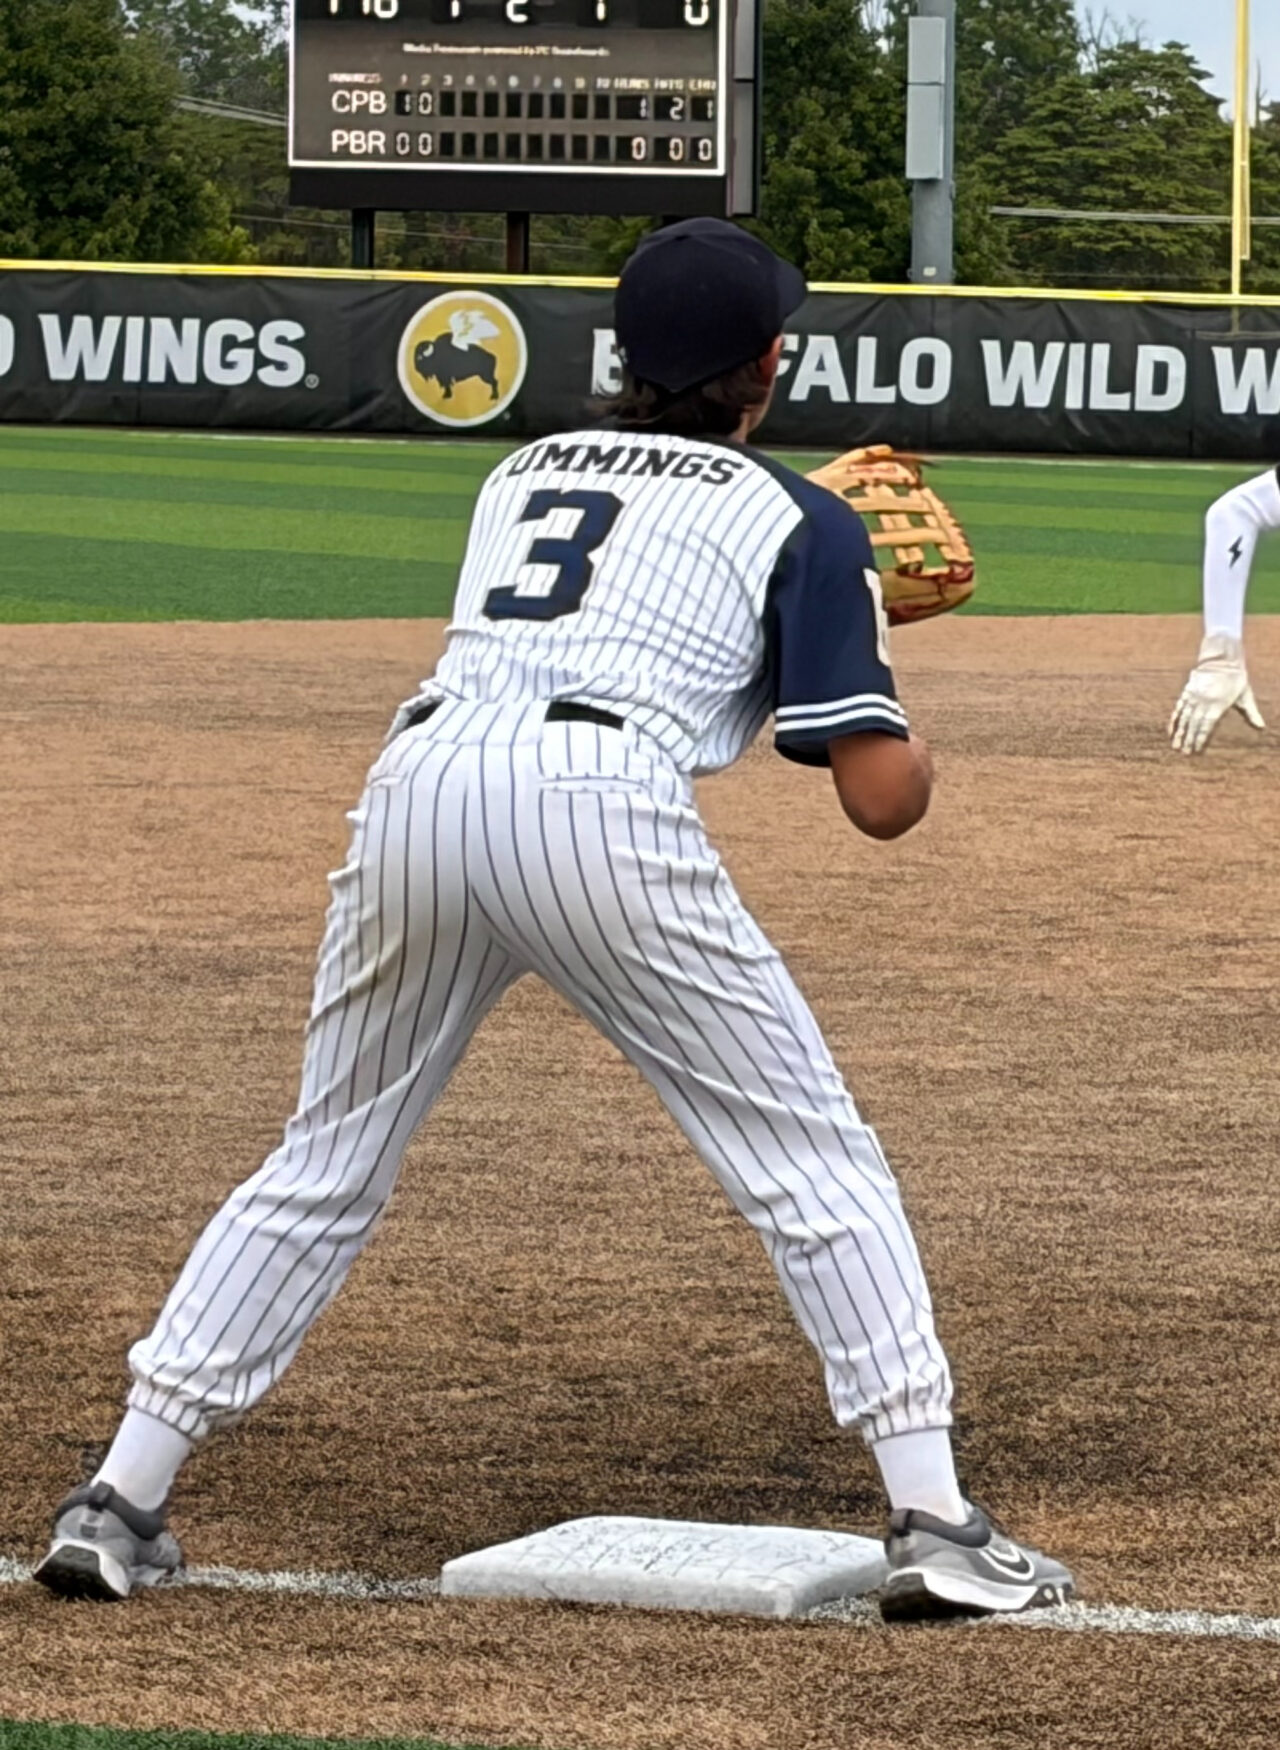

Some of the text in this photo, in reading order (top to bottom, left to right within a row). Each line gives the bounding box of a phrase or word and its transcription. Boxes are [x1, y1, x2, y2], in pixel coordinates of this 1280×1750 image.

[331, 89, 387, 114] CPB
[418, 92, 433, 115] 0
[669, 97, 684, 120] 2
[331, 129, 712, 161] PBR 0 0 0 0 0
[982, 339, 1186, 412] WILD
[482, 488, 625, 622] 3
